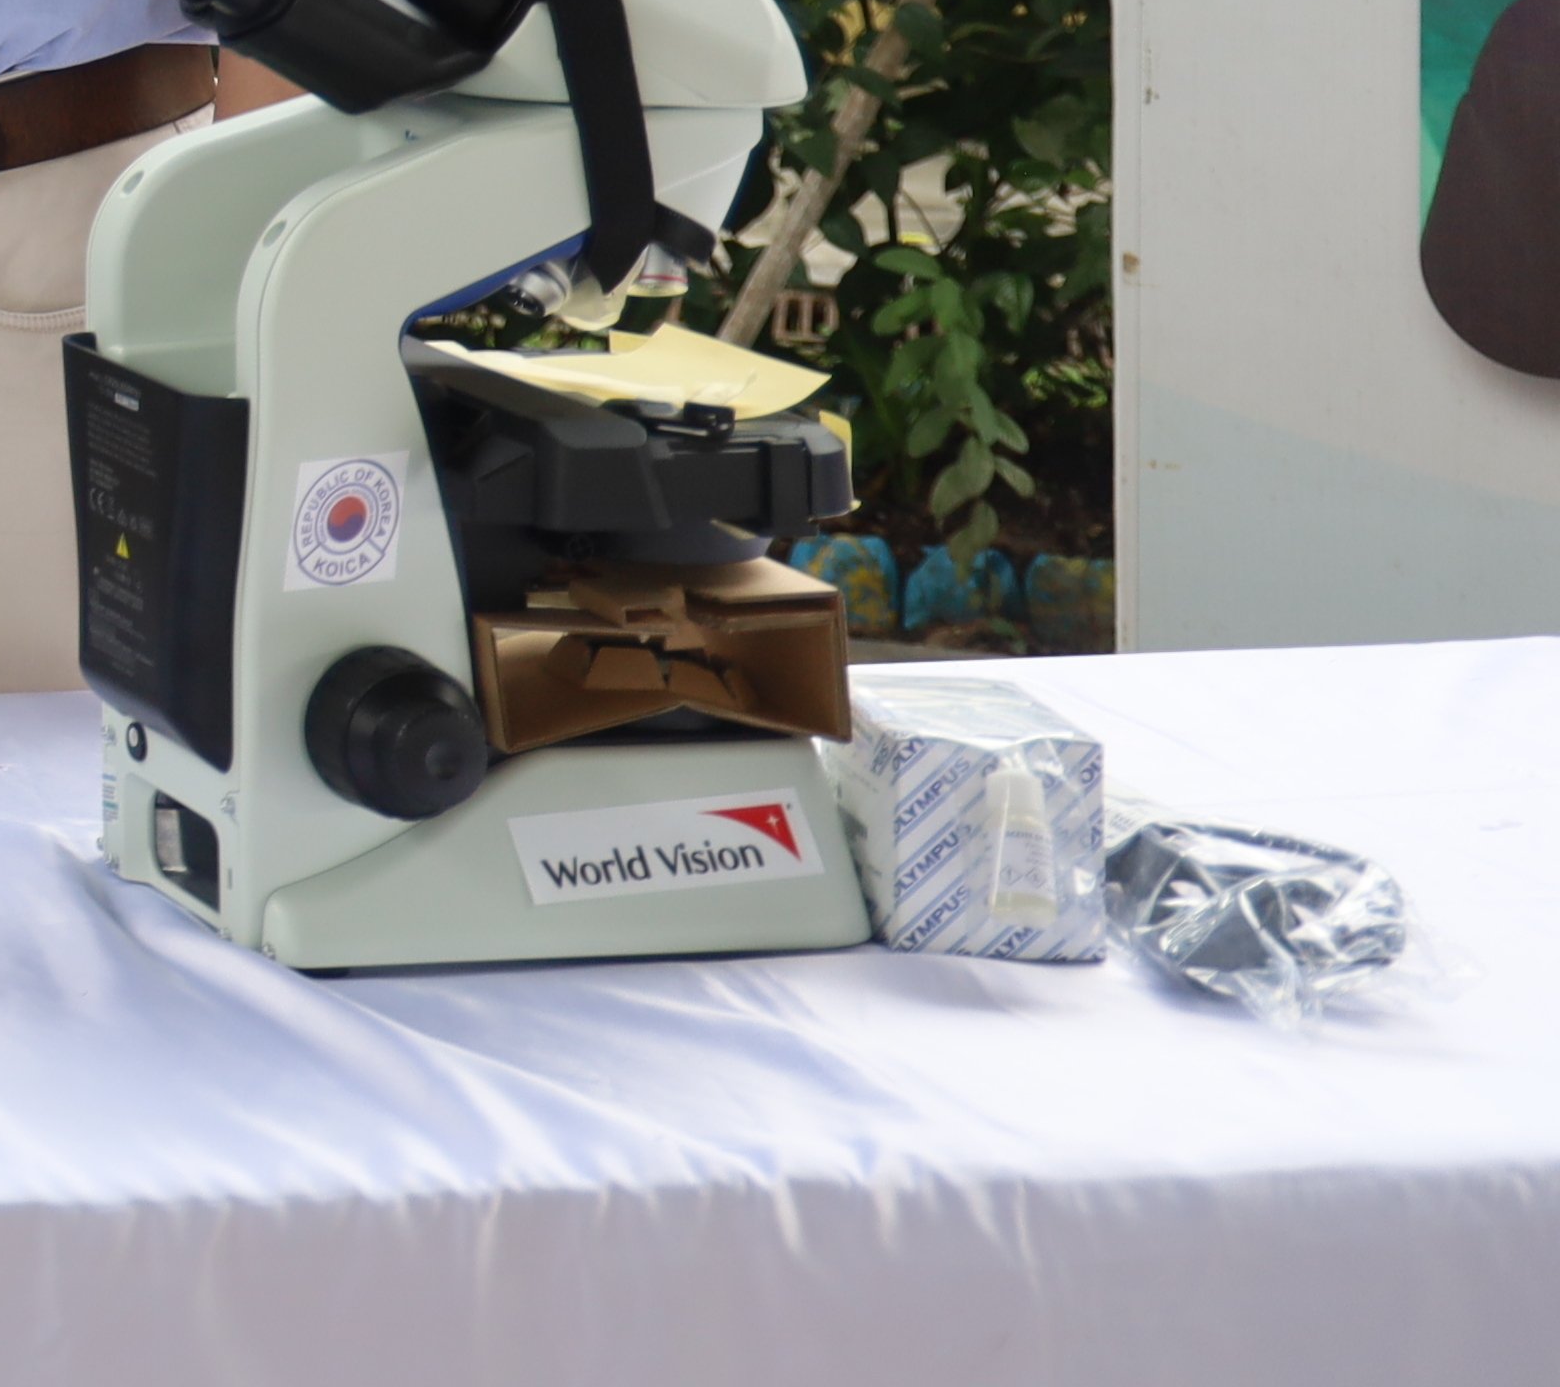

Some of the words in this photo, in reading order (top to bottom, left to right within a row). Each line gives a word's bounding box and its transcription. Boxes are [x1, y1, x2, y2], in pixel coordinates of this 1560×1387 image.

[300, 469, 349, 548] REPUBLIC
[354, 468, 375, 481] OF
[373, 477, 392, 537] KOREA
[312, 553, 371, 578] KOICA
[540, 845, 652, 889] World
[655, 839, 765, 877] Vision
